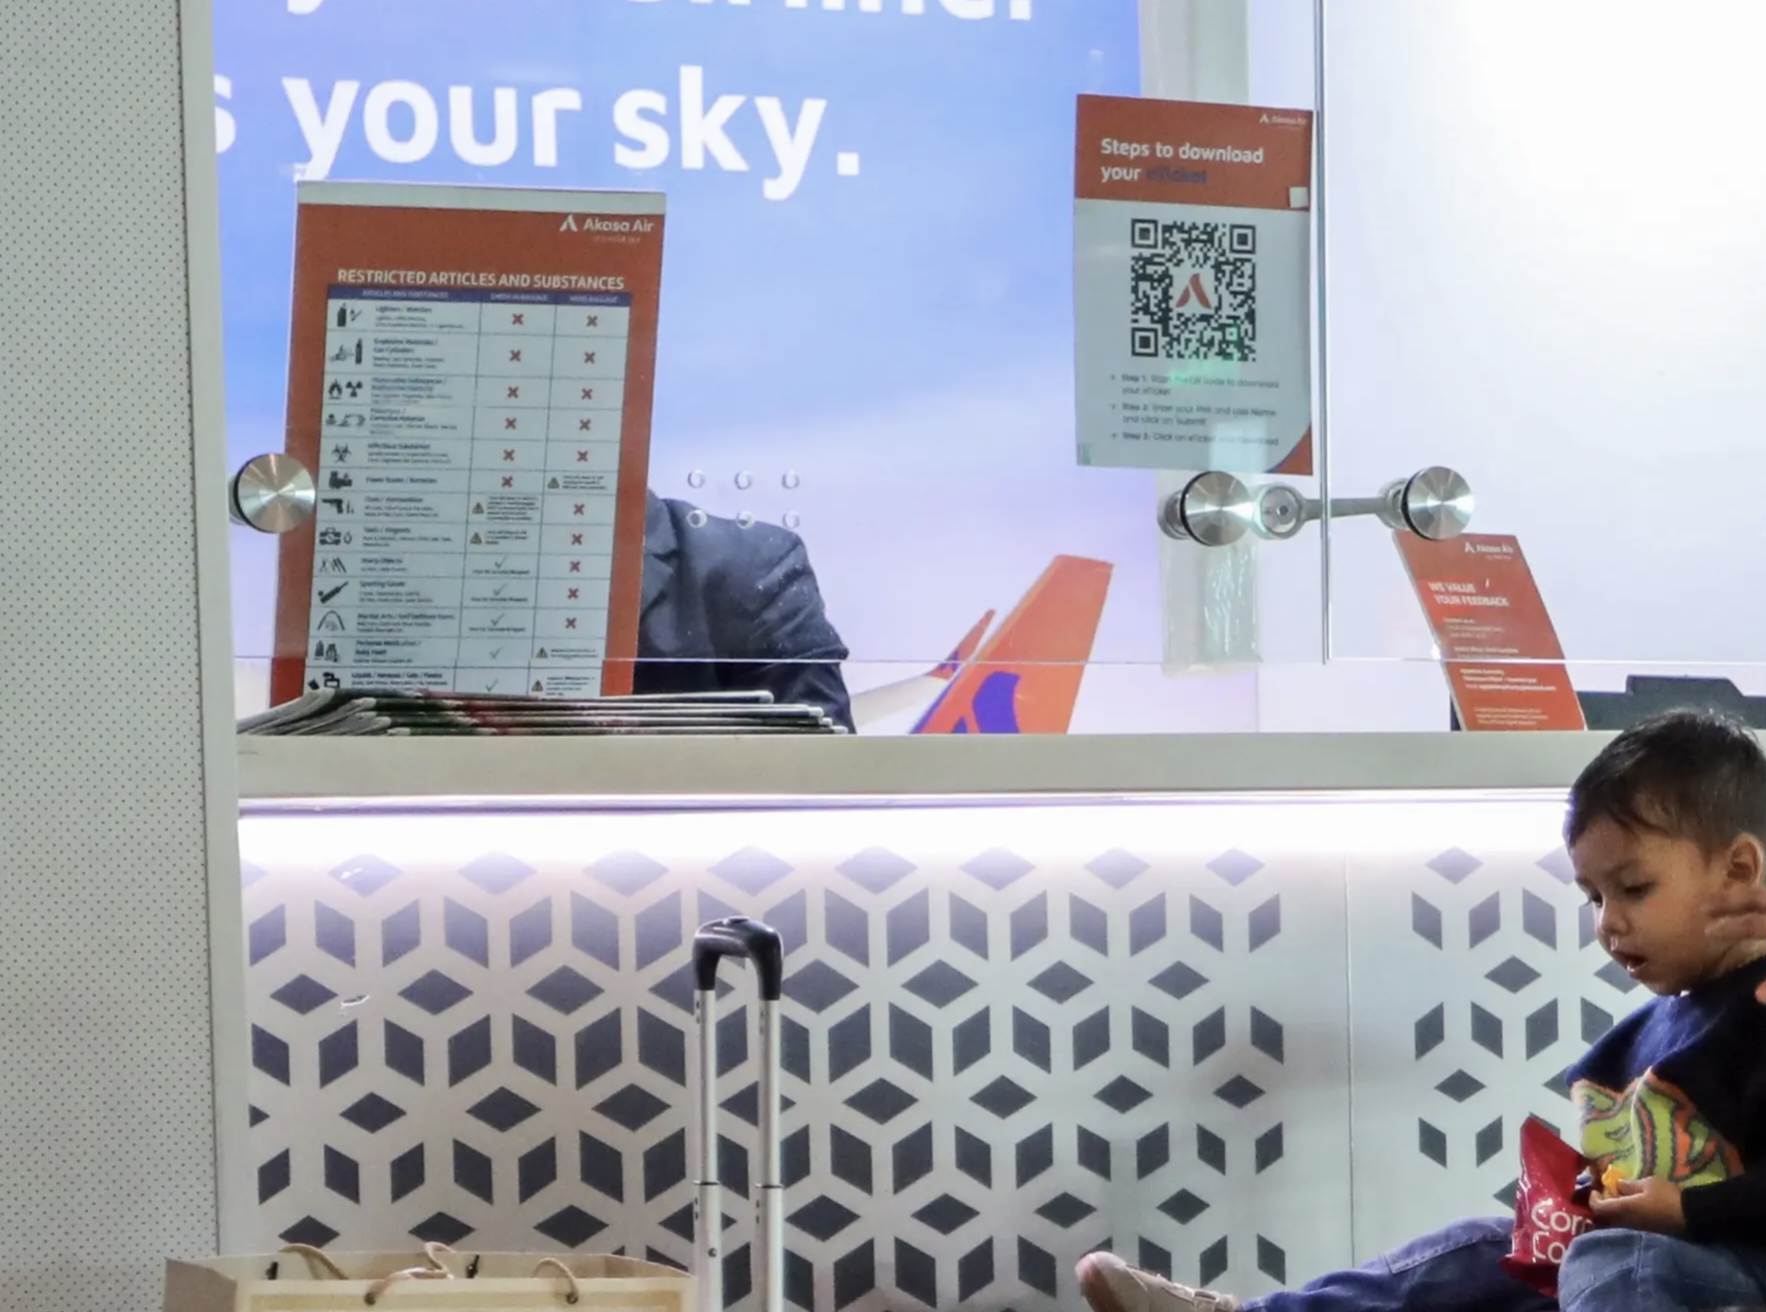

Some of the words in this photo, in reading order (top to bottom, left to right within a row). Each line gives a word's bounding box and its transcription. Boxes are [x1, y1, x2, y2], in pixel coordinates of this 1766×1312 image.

[282, 75, 582, 182] your
[612, 65, 860, 200] sky.
[1101, 138, 1150, 159] Steps
[1155, 142, 1174, 158] to
[1179, 143, 1264, 164] download
[1101, 166, 1142, 183] your
[583, 217, 630, 232] Akasa
[632, 218, 655, 233] Air
[337, 268, 427, 286] RESTRICTED
[428, 271, 496, 287] ARTICLES
[499, 273, 532, 289] AND
[534, 275, 625, 291] SUBSTANCES
[1434, 594, 1461, 605] YOUR
[1462, 595, 1510, 607] FEEDBACK
